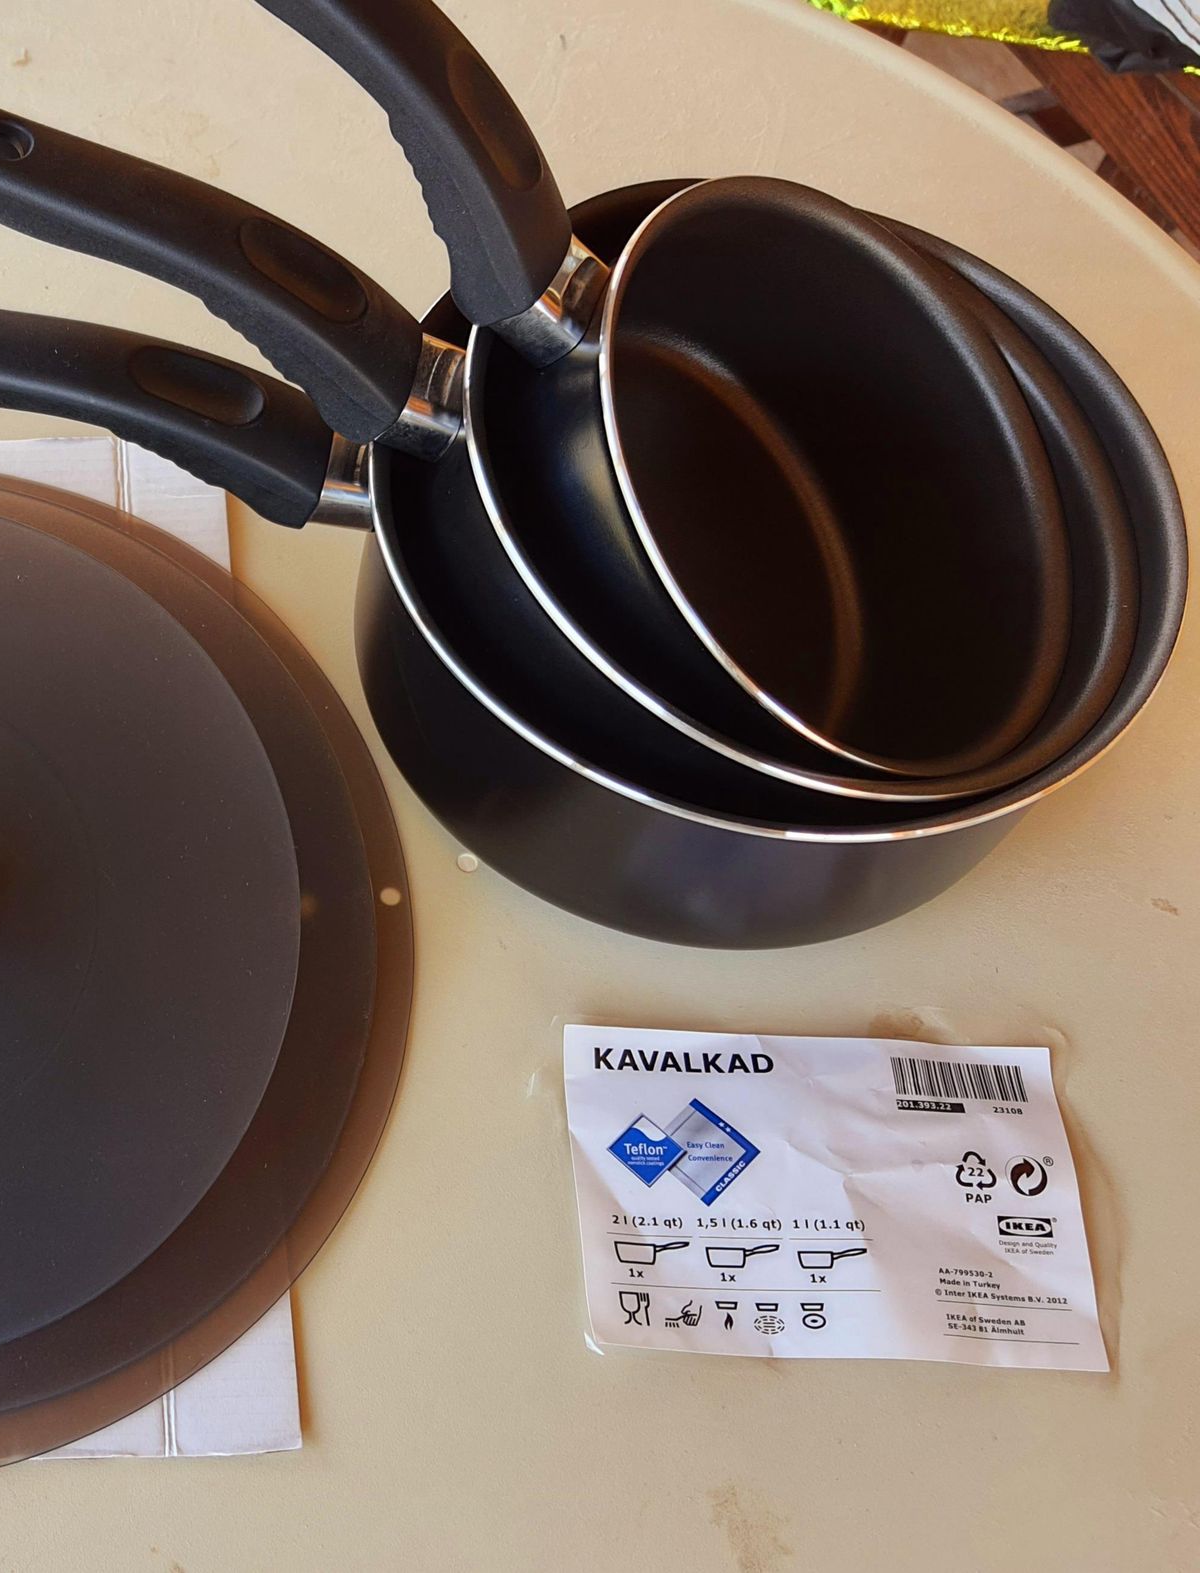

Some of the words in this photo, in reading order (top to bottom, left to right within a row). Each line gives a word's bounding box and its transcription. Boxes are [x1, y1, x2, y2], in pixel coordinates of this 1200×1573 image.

[593, 1047, 775, 1074] KAVALKAD
[896, 1100, 952, 1111] 201.393.22
[992, 1106, 1023, 1115] 23108
[686, 1141, 703, 1150] Easy
[704, 1141, 725, 1149] Clean
[715, 1160, 746, 1193] CLASSIC
[967, 1167, 985, 1177] 22
[965, 1193, 992, 1204] PAP
[612, 1215, 619, 1225] 2
[632, 1215, 658, 1228] (2.1
[663, 1217, 683, 1230] qt)
[697, 1218, 718, 1229] 1,5
[730, 1218, 757, 1231] (1.6
[761, 1219, 782, 1231] qt)
[793, 1219, 800, 1228] 1
[813, 1219, 841, 1231] (1.1
[845, 1220, 866, 1232] qt)
[1005, 1221, 1047, 1232] IKEA
[999, 1240, 1020, 1248] Design
[1035, 1241, 1057, 1249] Quality
[629, 1268, 644, 1278] 1x
[720, 1272, 736, 1282] 1x
[938, 1267, 994, 1278] AA-799530-2
[810, 1274, 827, 1283] 1x
[939, 1278, 961, 1286] Made
[962, 1279, 971, 1287] in
[973, 1280, 1000, 1290] Turkey
[944, 1289, 965, 1297] Inter
[967, 1291, 989, 1299] IKEA
[990, 1293, 1026, 1303] Systems
[1027, 1295, 1044, 1303] B.V.
[1046, 1297, 1068, 1305] 2012
[946, 1313, 967, 1322] IKEA
[969, 1315, 977, 1323] of
[978, 1316, 1012, 1326] Sweden
[947, 1322, 977, 1332] SE-343
